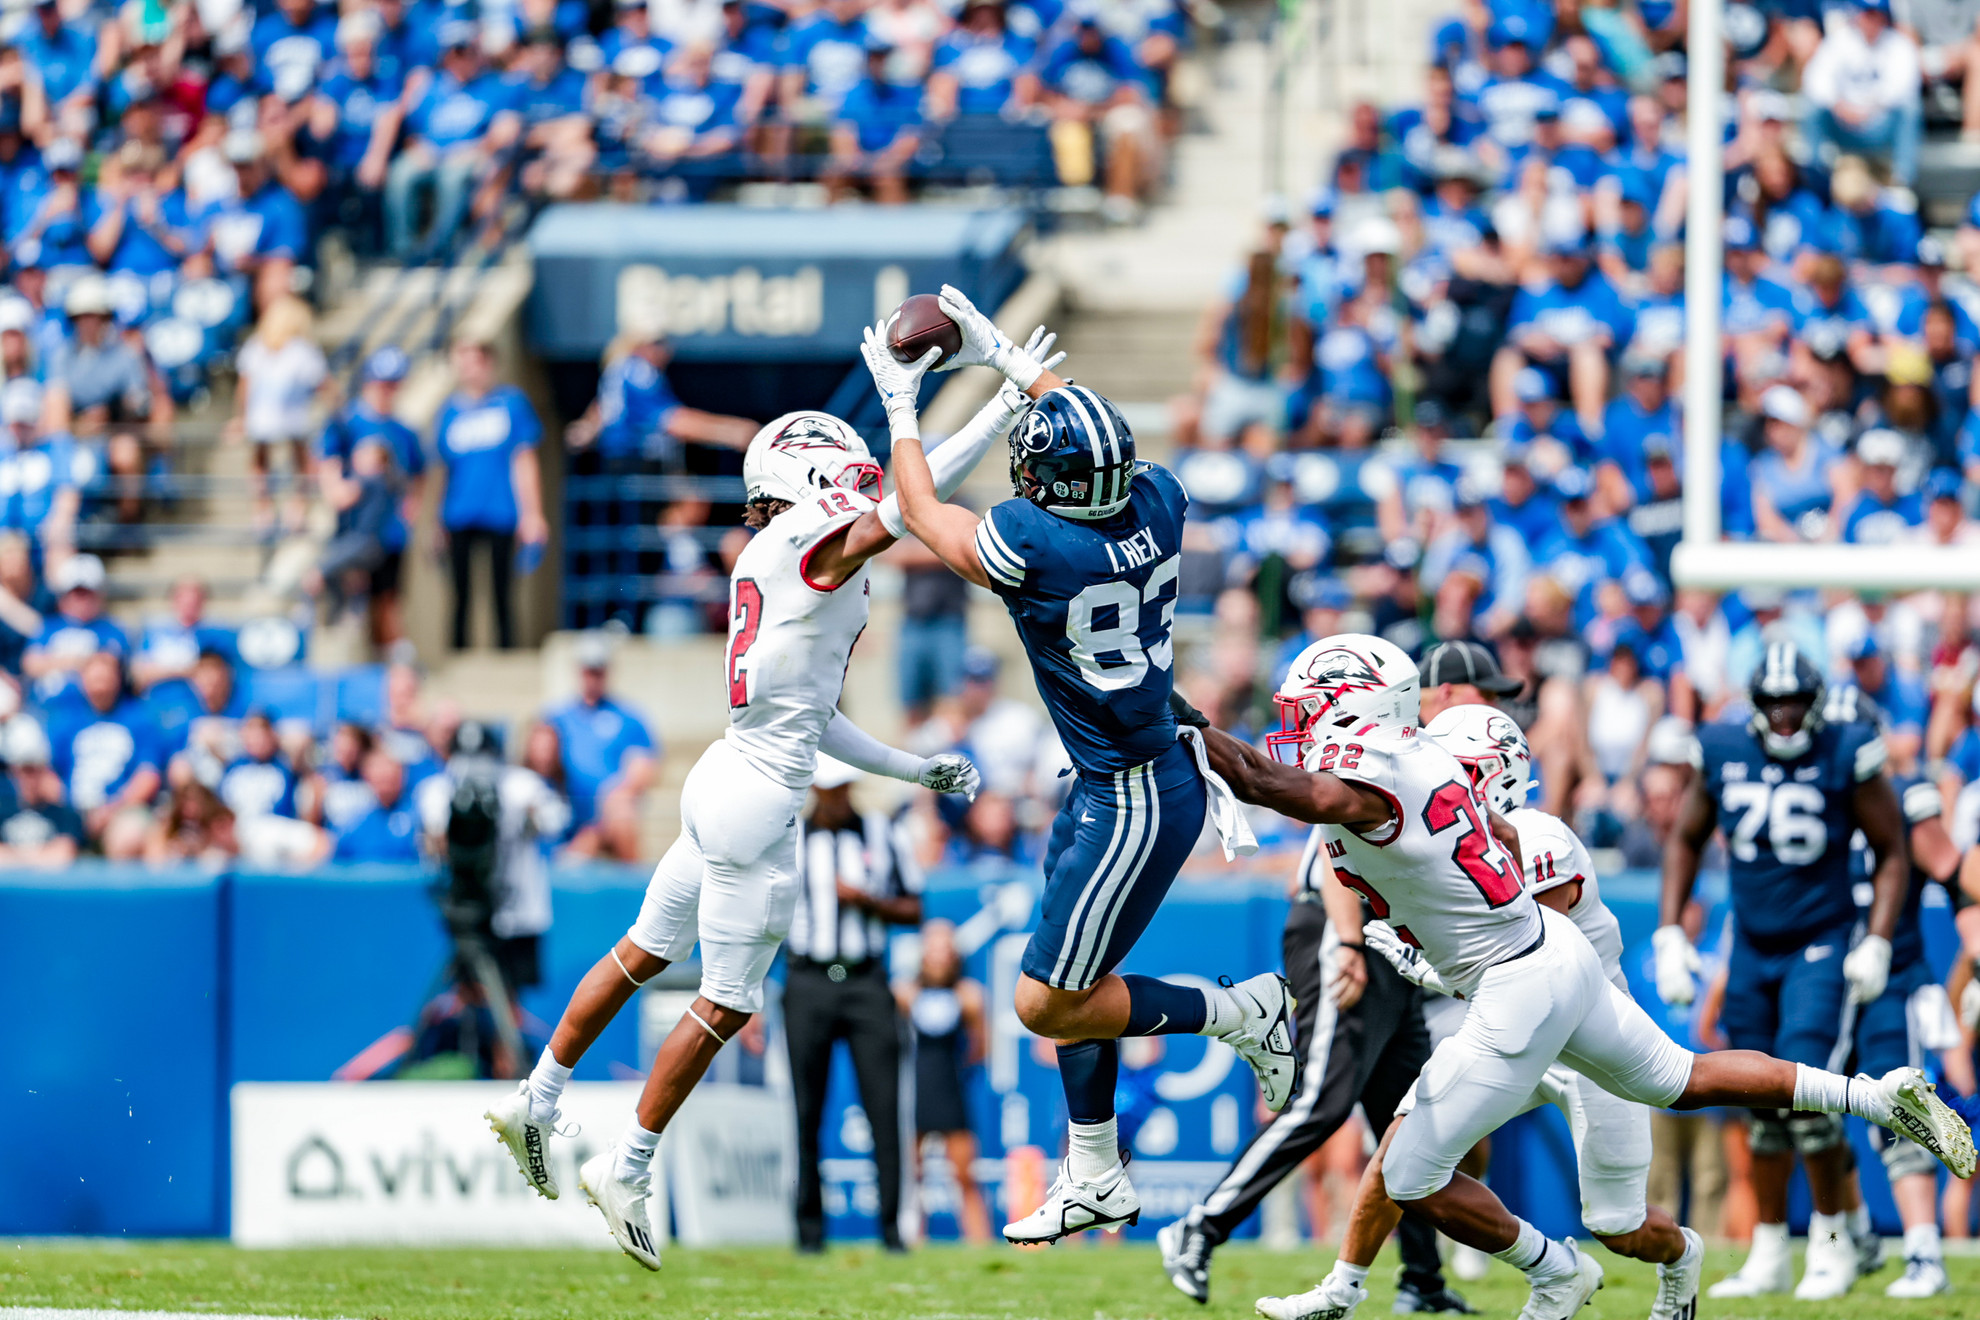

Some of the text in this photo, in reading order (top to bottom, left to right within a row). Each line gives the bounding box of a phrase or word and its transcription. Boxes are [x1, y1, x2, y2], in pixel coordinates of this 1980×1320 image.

[616, 264, 823, 338] Portal
[817, 492, 858, 518] 12
[1072, 491, 1085, 499] 83
[726, 577, 764, 709] 2
[1065, 552, 1181, 692] 83
[1319, 742, 1364, 771] 22
[1721, 781, 1828, 866] 76
[1533, 851, 1556, 883] 11
[524, 1123, 548, 1186] ADIZERO
[1892, 1105, 1945, 1155] ADIZERO
